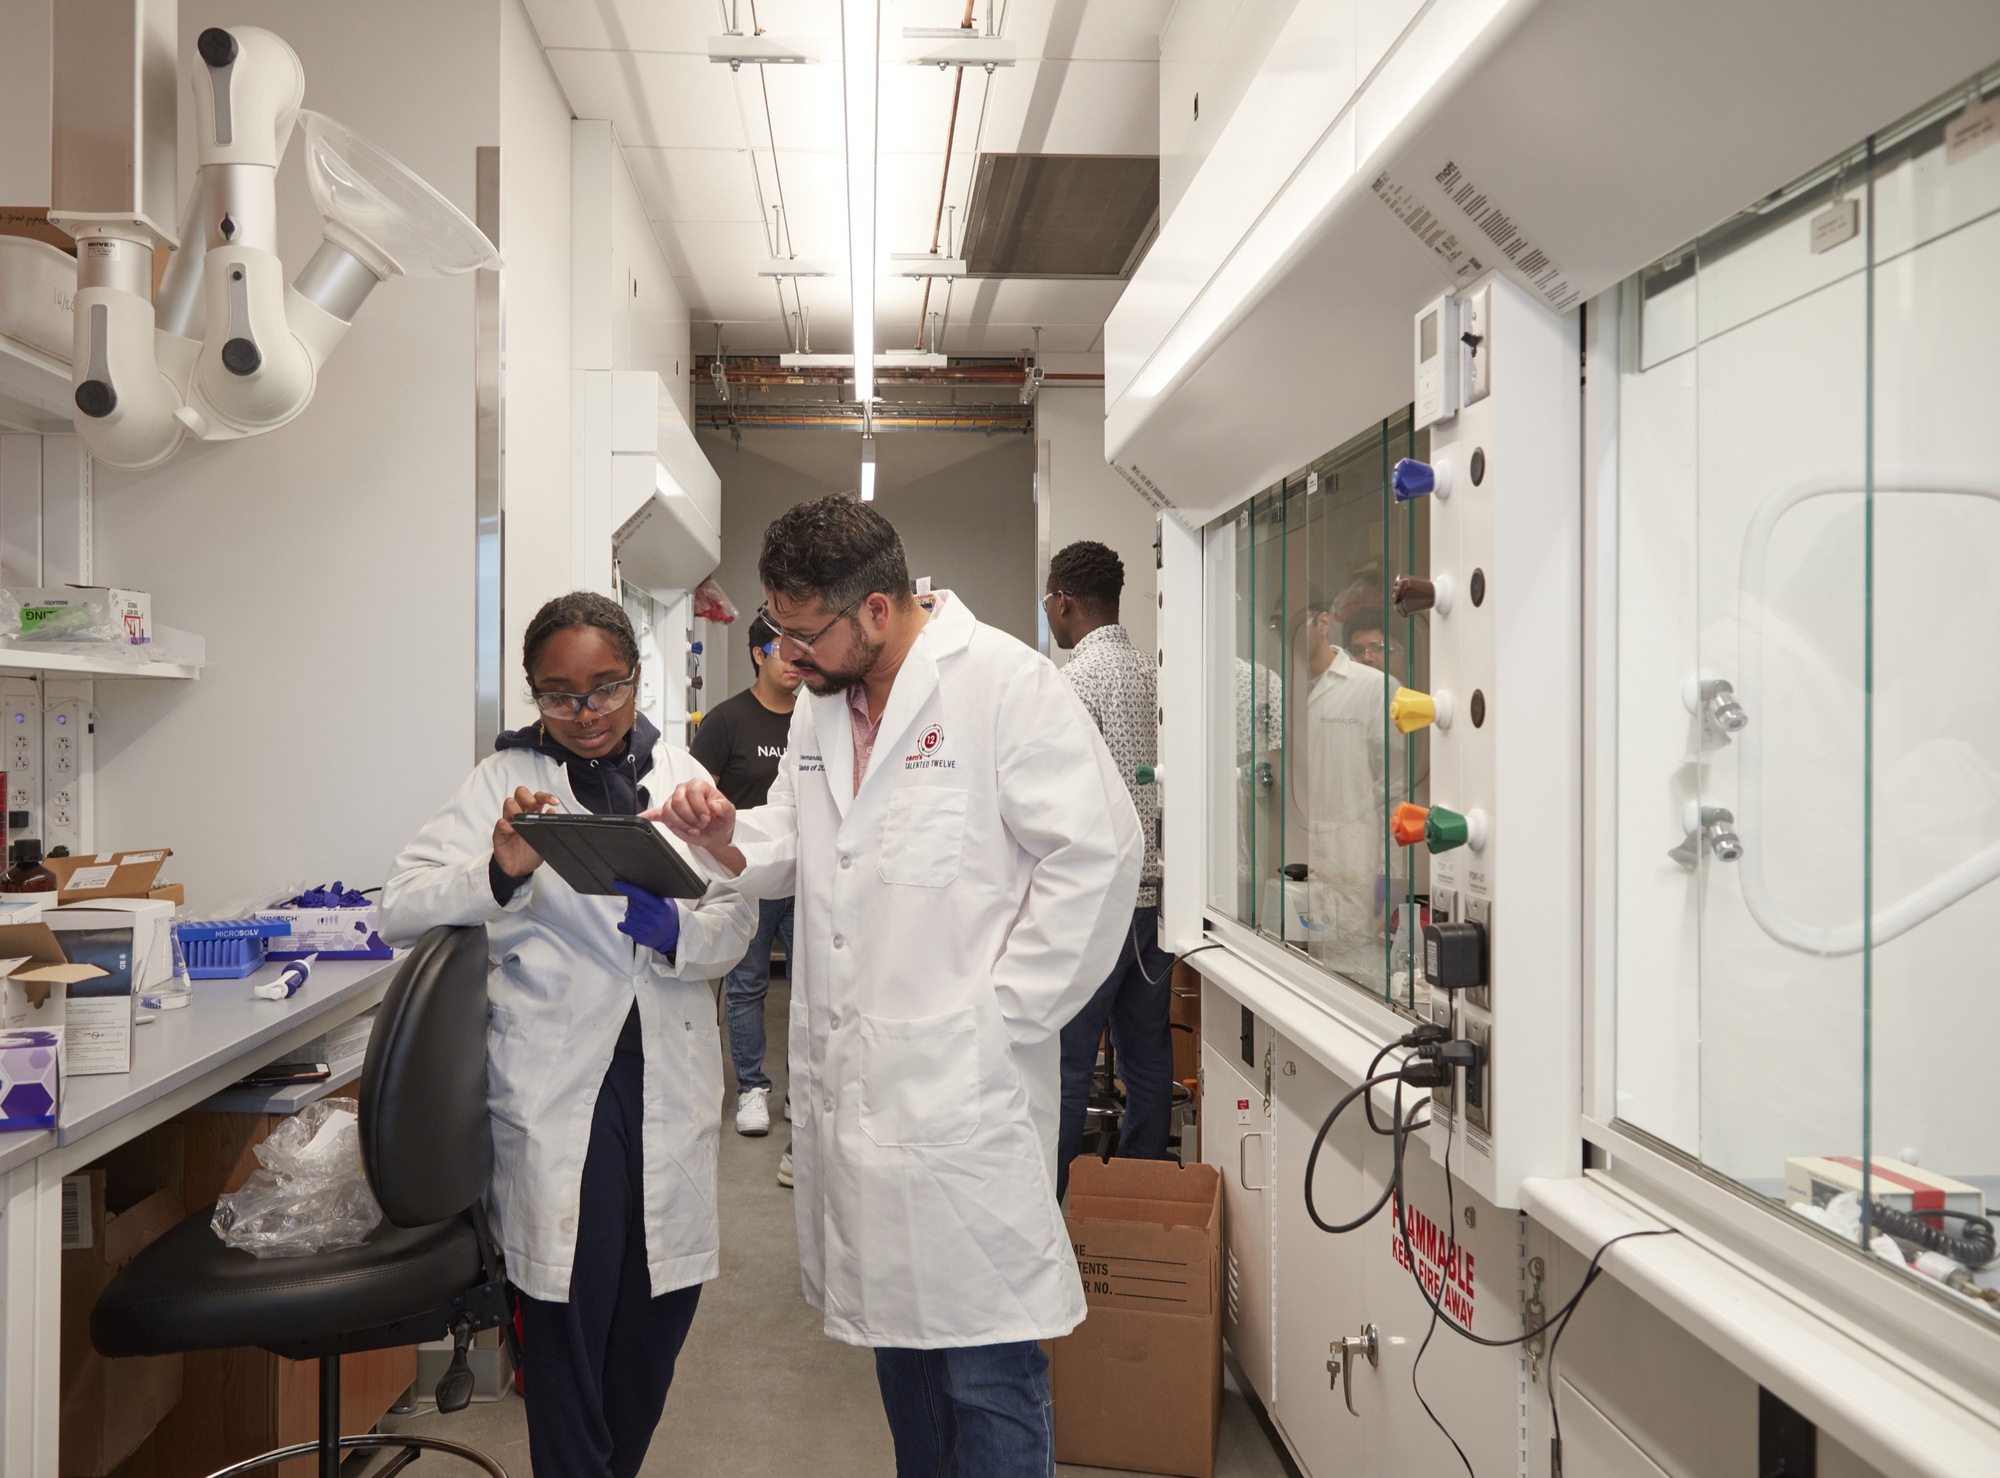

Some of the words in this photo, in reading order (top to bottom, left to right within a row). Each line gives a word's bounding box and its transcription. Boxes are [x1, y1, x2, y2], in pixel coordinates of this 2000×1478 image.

[927, 735, 935, 745] 12
[905, 761, 930, 770] TALENTED
[931, 760, 956, 769] TWELVE
[215, 929, 259, 938] MICROSOLV
[119, 960, 126, 970] BD
[1392, 1188, 1474, 1300] FAMMABLE
[1077, 1261, 1109, 1276] TENTS
[1094, 1281, 1113, 1295] NO.
[1419, 1258, 1440, 1299] FIRE
[1444, 1283, 1474, 1331] AWAY
